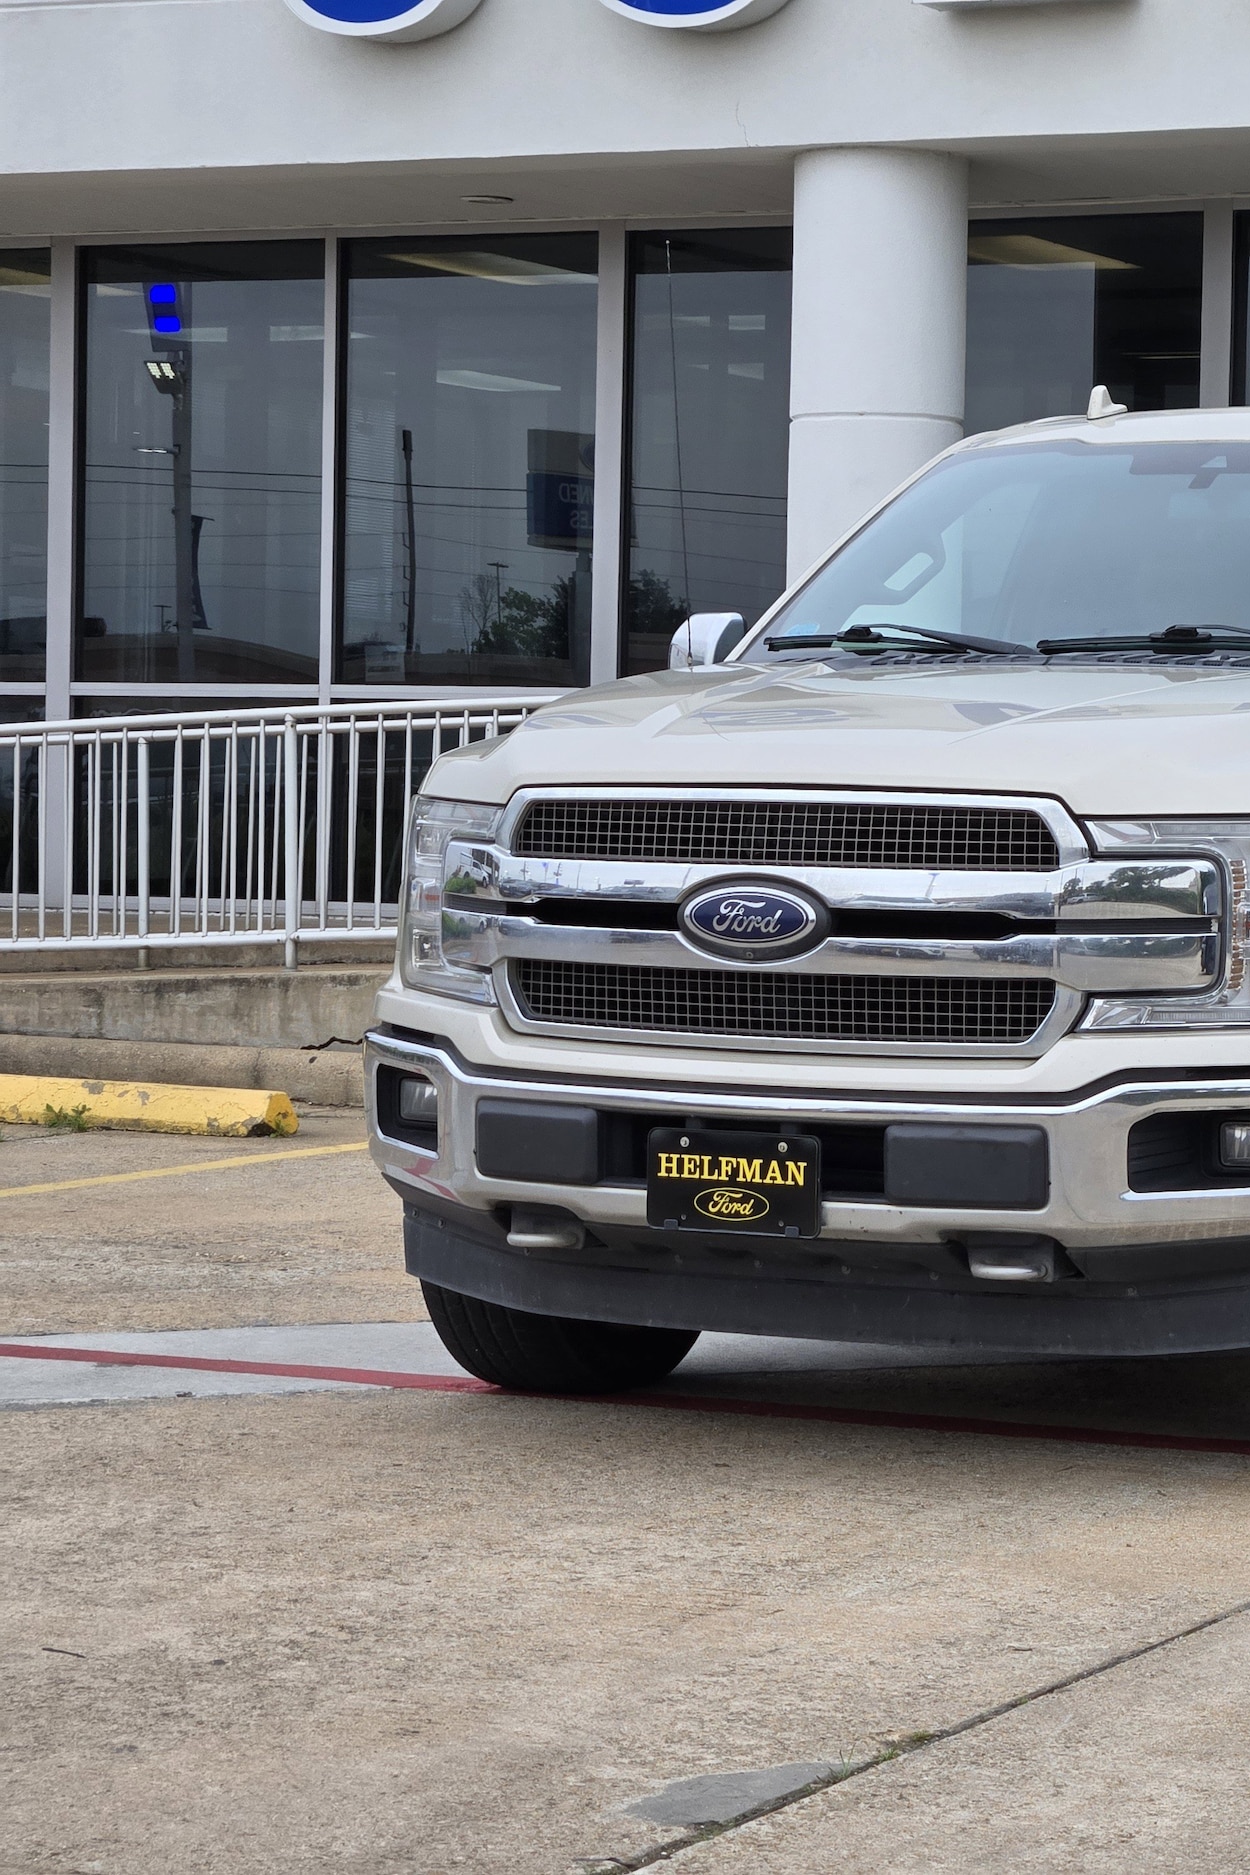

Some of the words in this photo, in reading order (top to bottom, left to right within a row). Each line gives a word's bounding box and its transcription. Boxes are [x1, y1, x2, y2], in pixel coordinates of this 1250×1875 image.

[712, 899, 782, 933] Ford
[657, 1152, 807, 1186] HELFMAN
[708, 1190, 754, 1216] Ford
